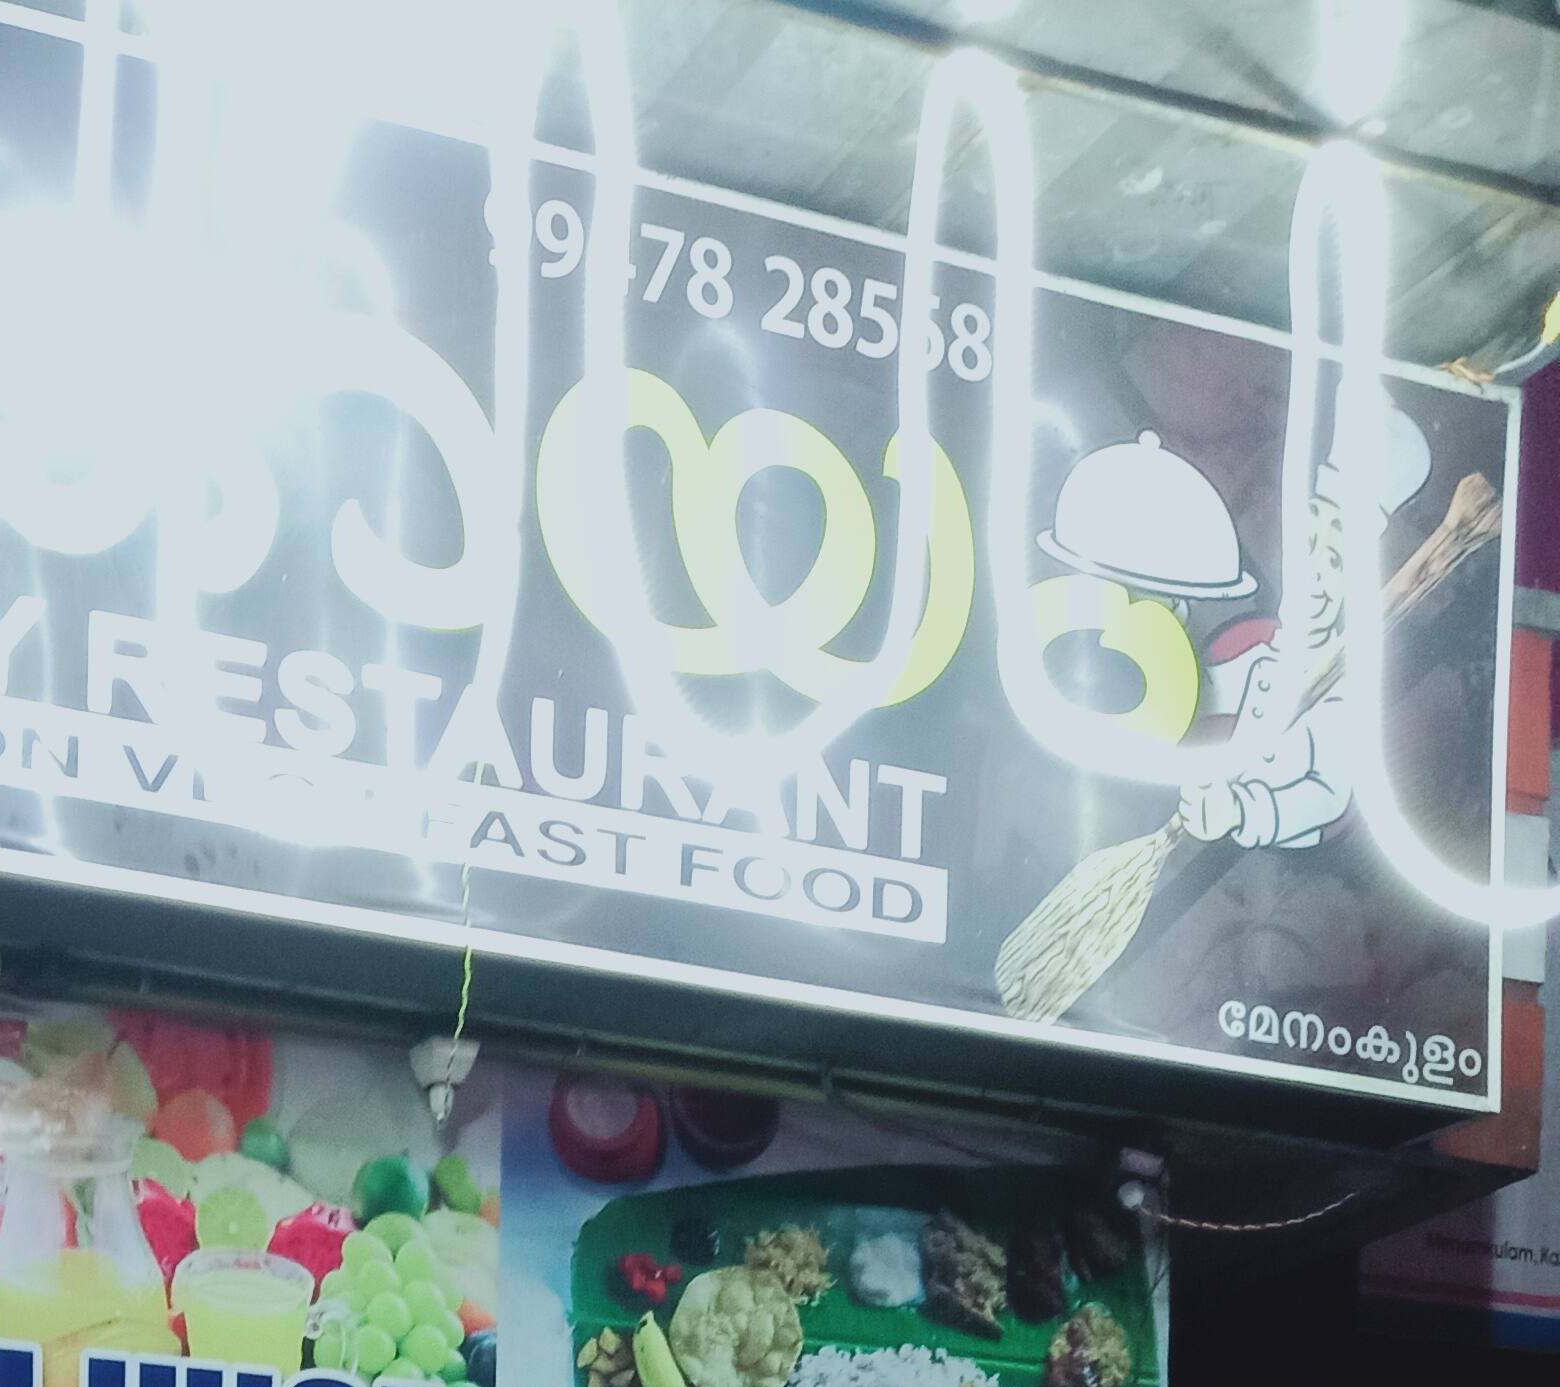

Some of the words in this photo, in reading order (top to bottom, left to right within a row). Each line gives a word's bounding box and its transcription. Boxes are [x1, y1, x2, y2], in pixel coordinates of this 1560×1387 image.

[484, 190, 734, 319] 978
[87, 610, 947, 860] RESTAURANT
[681, 844, 925, 924] FOOD
[1218, 1000, 1482, 1086] മേനംകുളം
